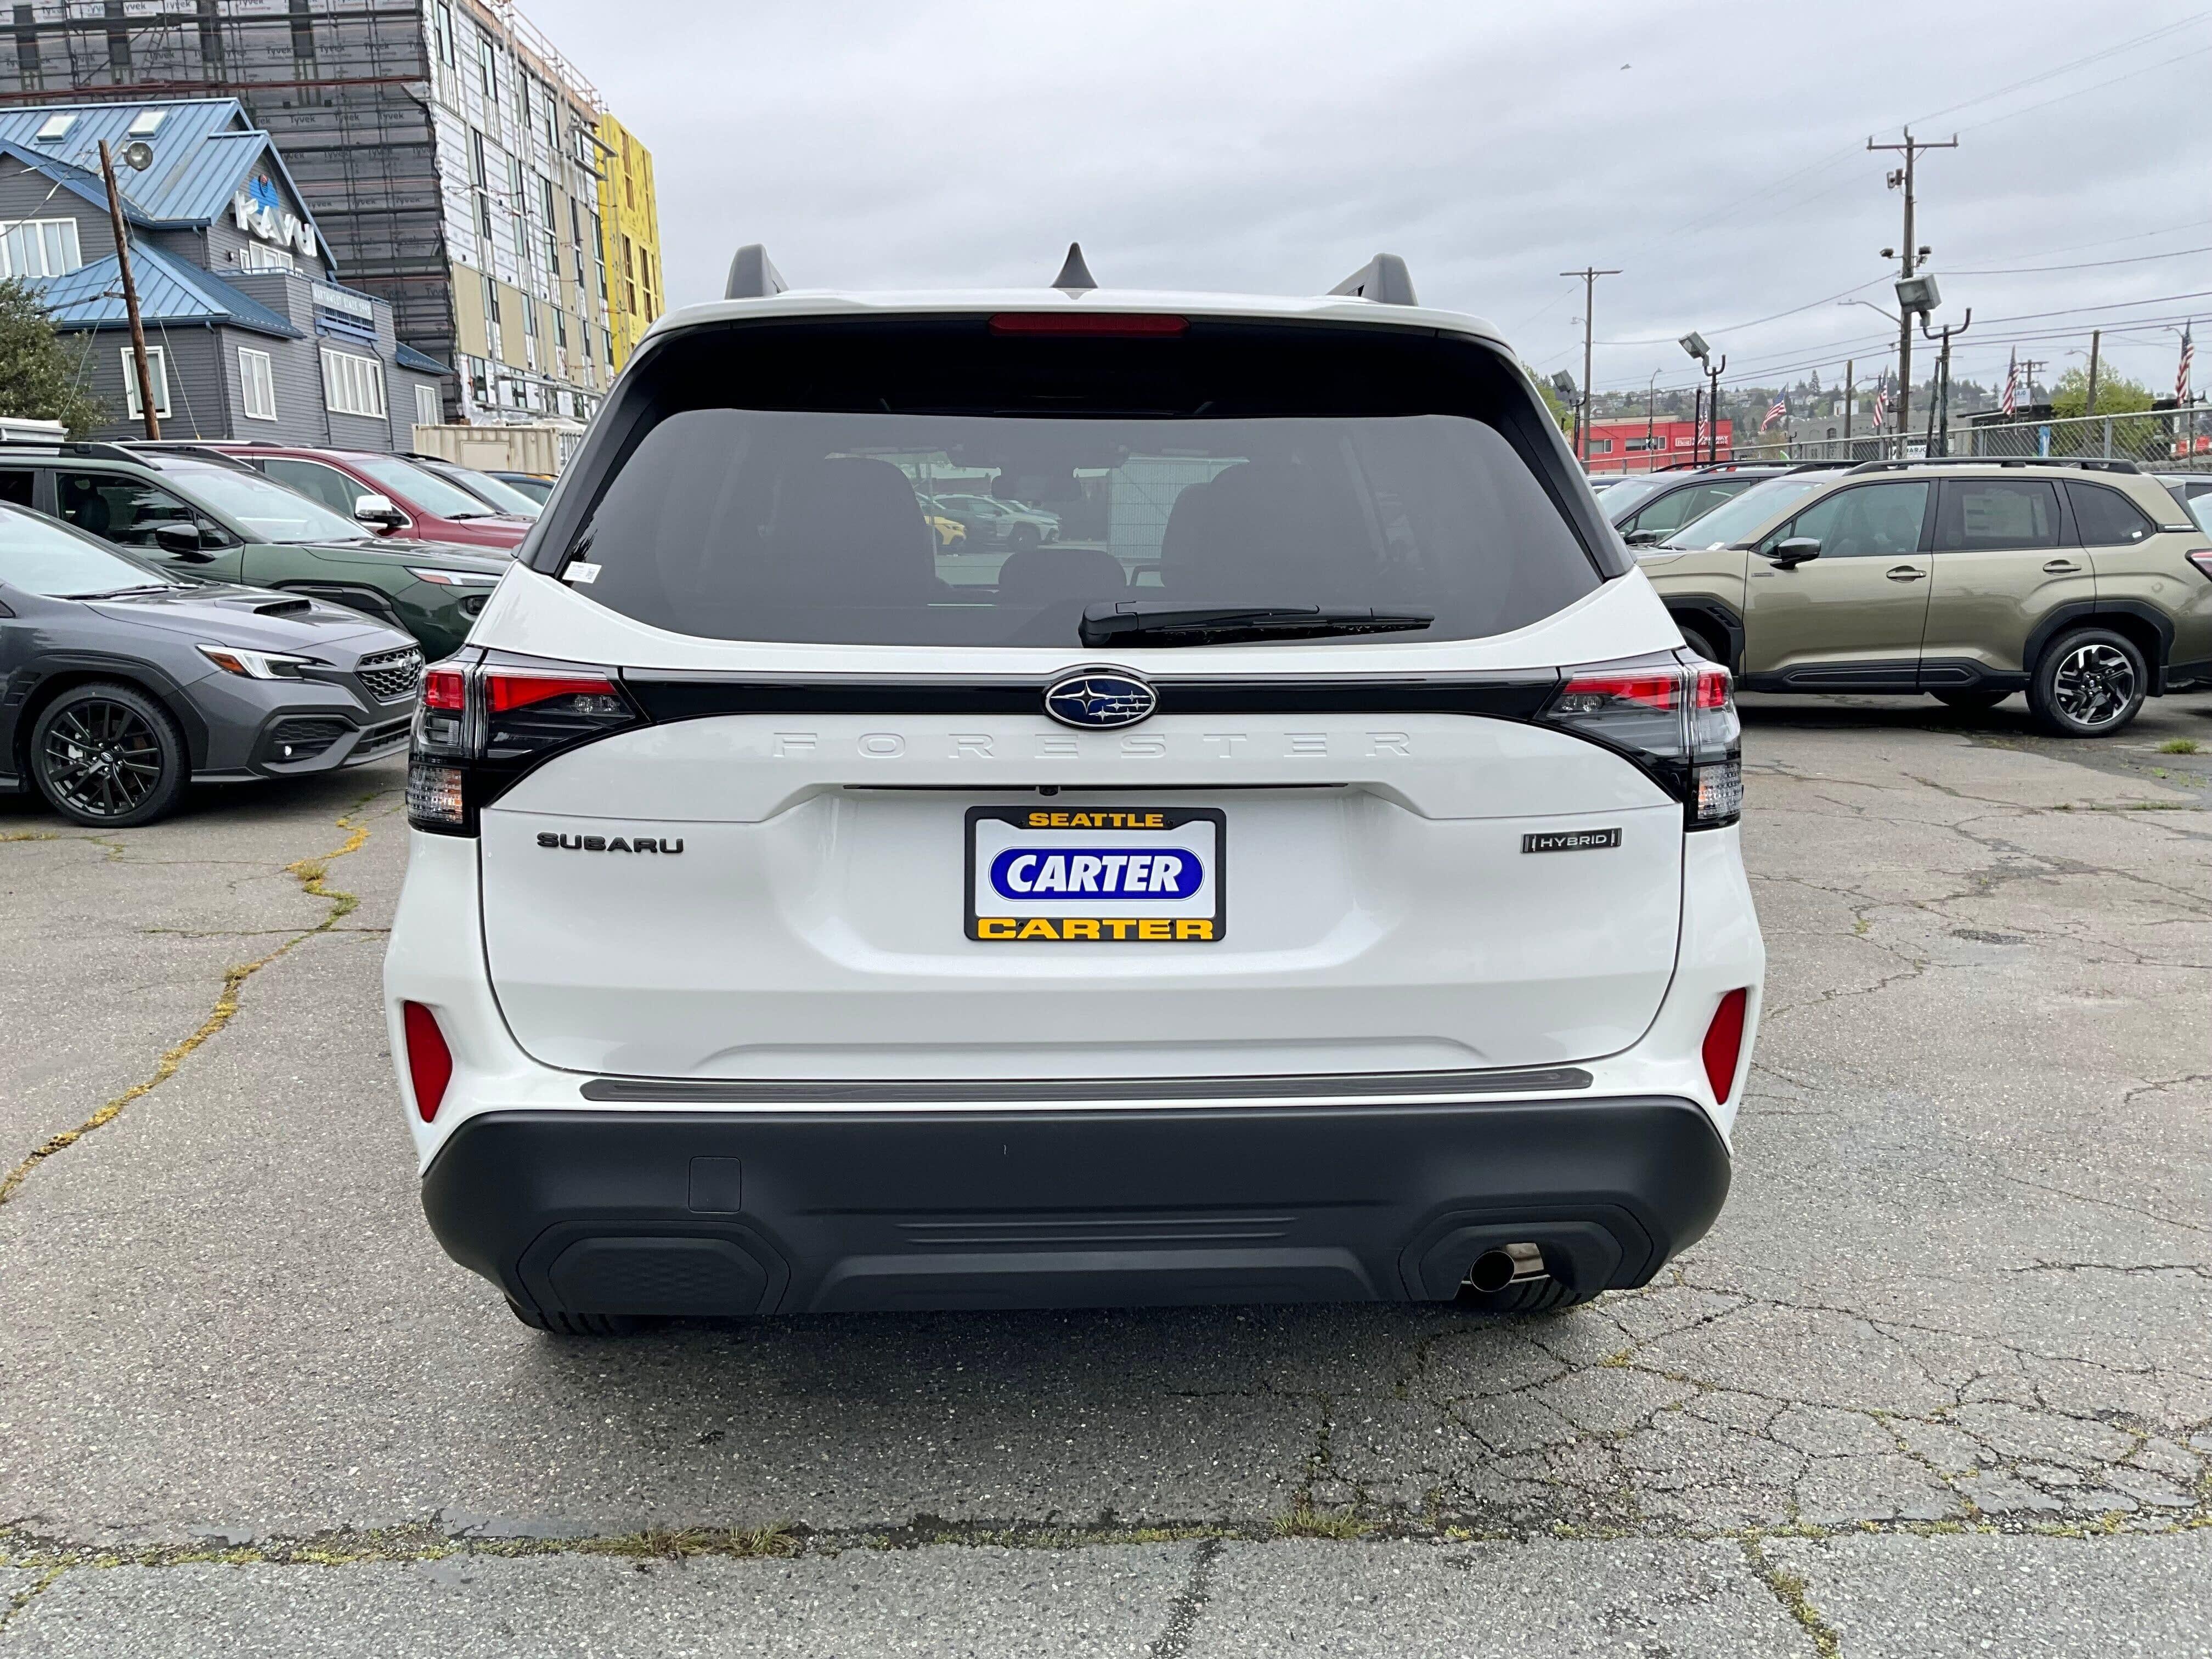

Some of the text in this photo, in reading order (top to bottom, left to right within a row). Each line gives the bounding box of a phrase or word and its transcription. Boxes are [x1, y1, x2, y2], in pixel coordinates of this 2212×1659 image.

[125, 3, 146, 12] yvek
[291, 115, 317, 126] Tyvek
[379, 111, 405, 120] Tyvek
[234, 190, 318, 257] KAVU
[772, 732, 1413, 760] FORESTER
[1028, 812, 1164, 827] SEATTLE
[537, 831, 684, 854] SUBARU
[1540, 834, 1607, 848] HYBRID
[1006, 854, 1183, 893] CARTER
[977, 918, 1214, 940] CARTER
